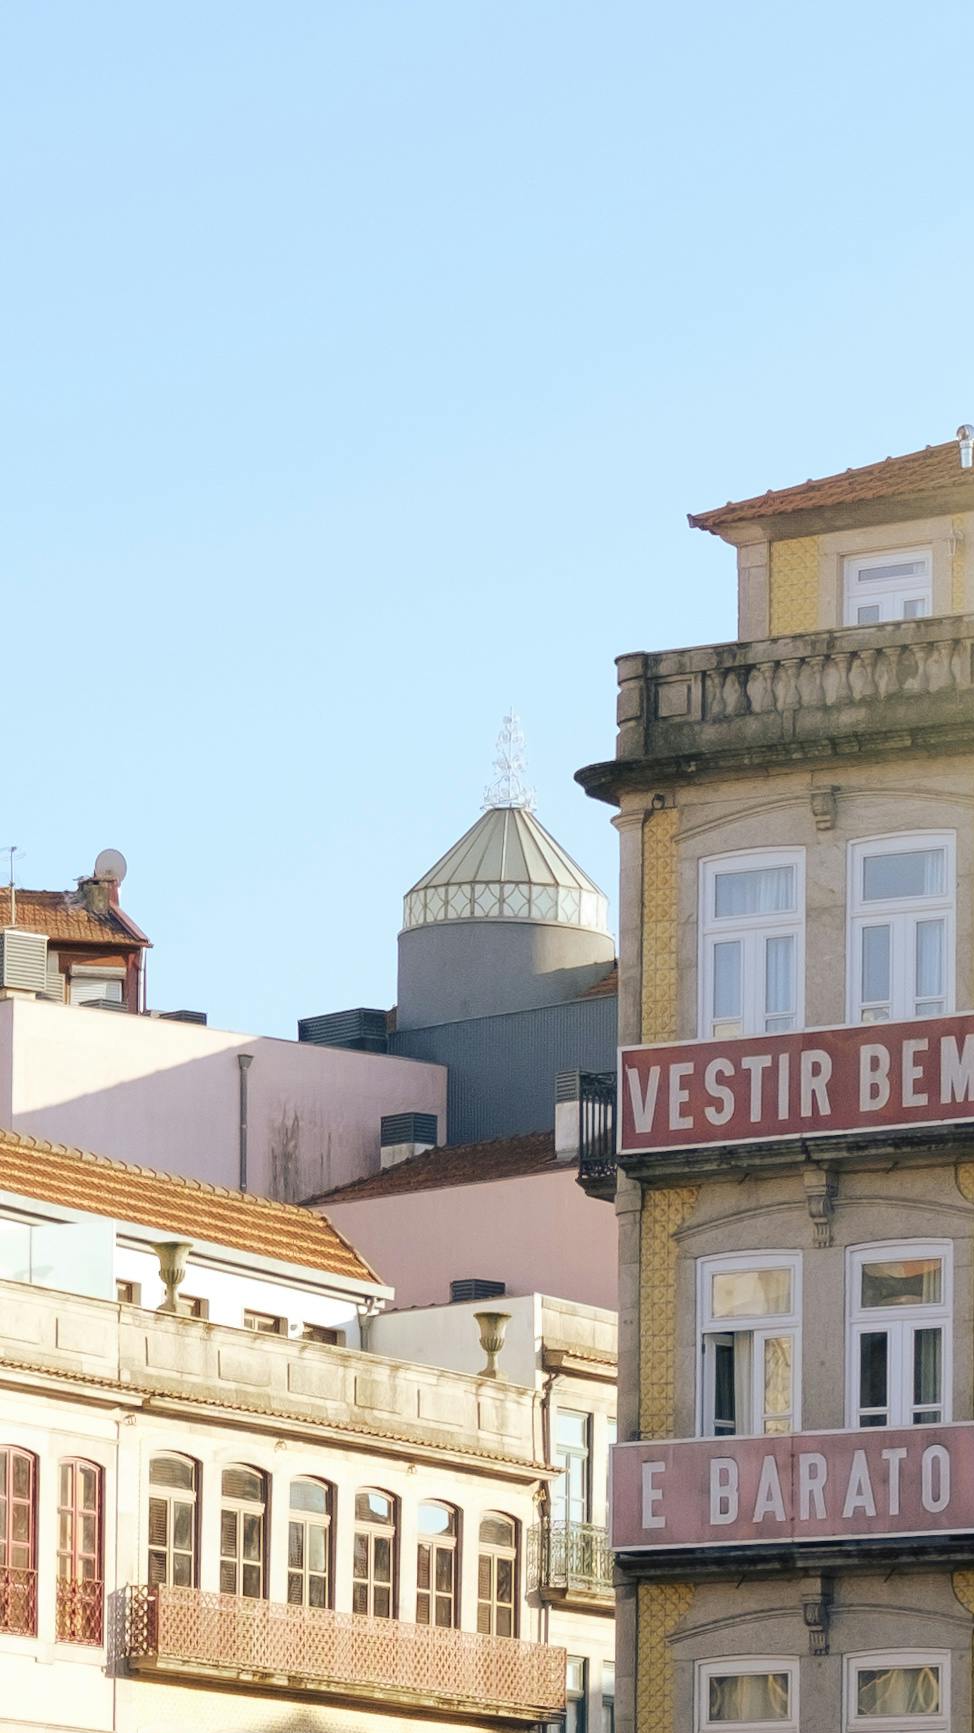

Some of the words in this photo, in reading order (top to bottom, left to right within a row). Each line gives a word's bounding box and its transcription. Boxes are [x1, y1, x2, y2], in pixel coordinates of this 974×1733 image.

[626, 1049, 832, 1134] VESTIR
[641, 1461, 667, 1529] E
[709, 1444, 950, 1526] BARATO
